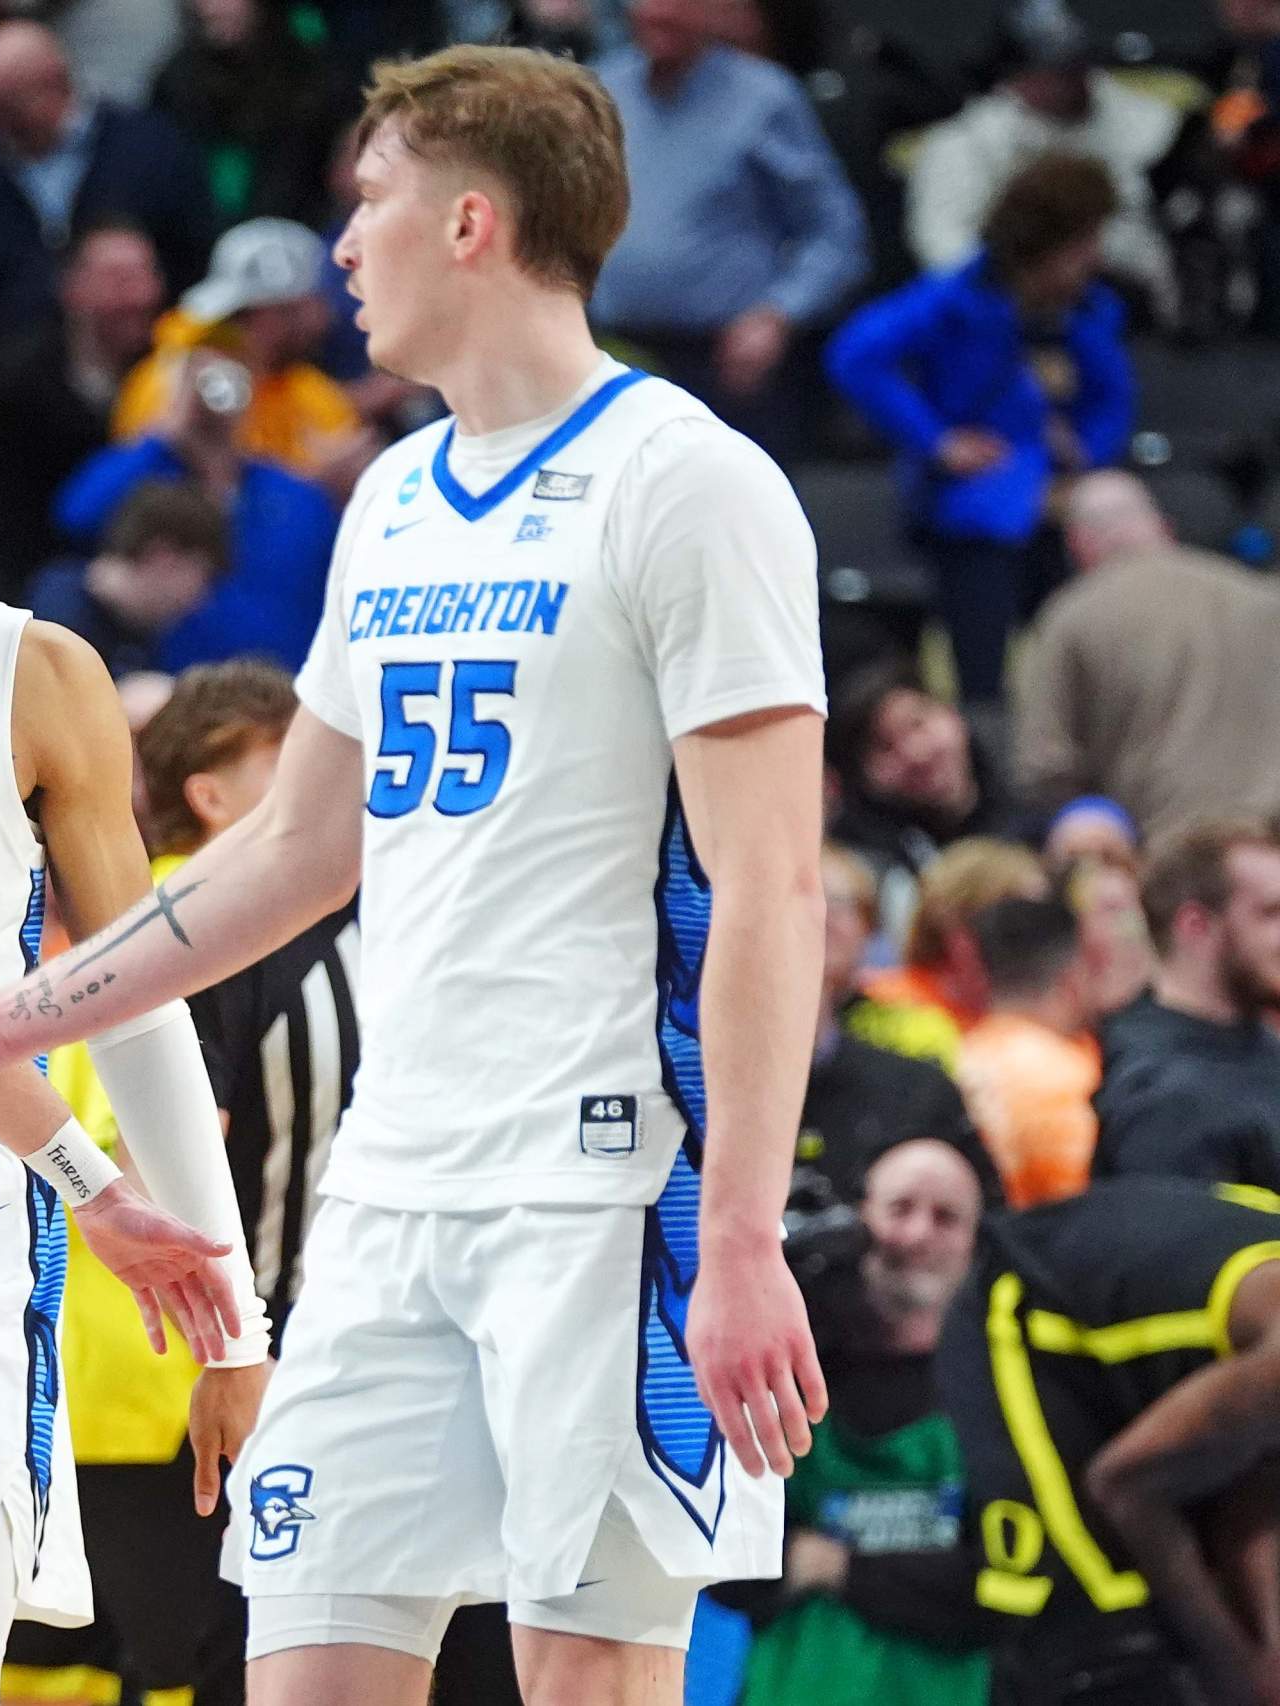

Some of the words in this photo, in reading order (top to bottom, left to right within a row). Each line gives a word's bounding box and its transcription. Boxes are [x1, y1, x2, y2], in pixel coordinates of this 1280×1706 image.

[349, 580, 570, 643] CREIGHTON
[366, 660, 518, 819] 55
[591, 1099, 624, 1120] 46
